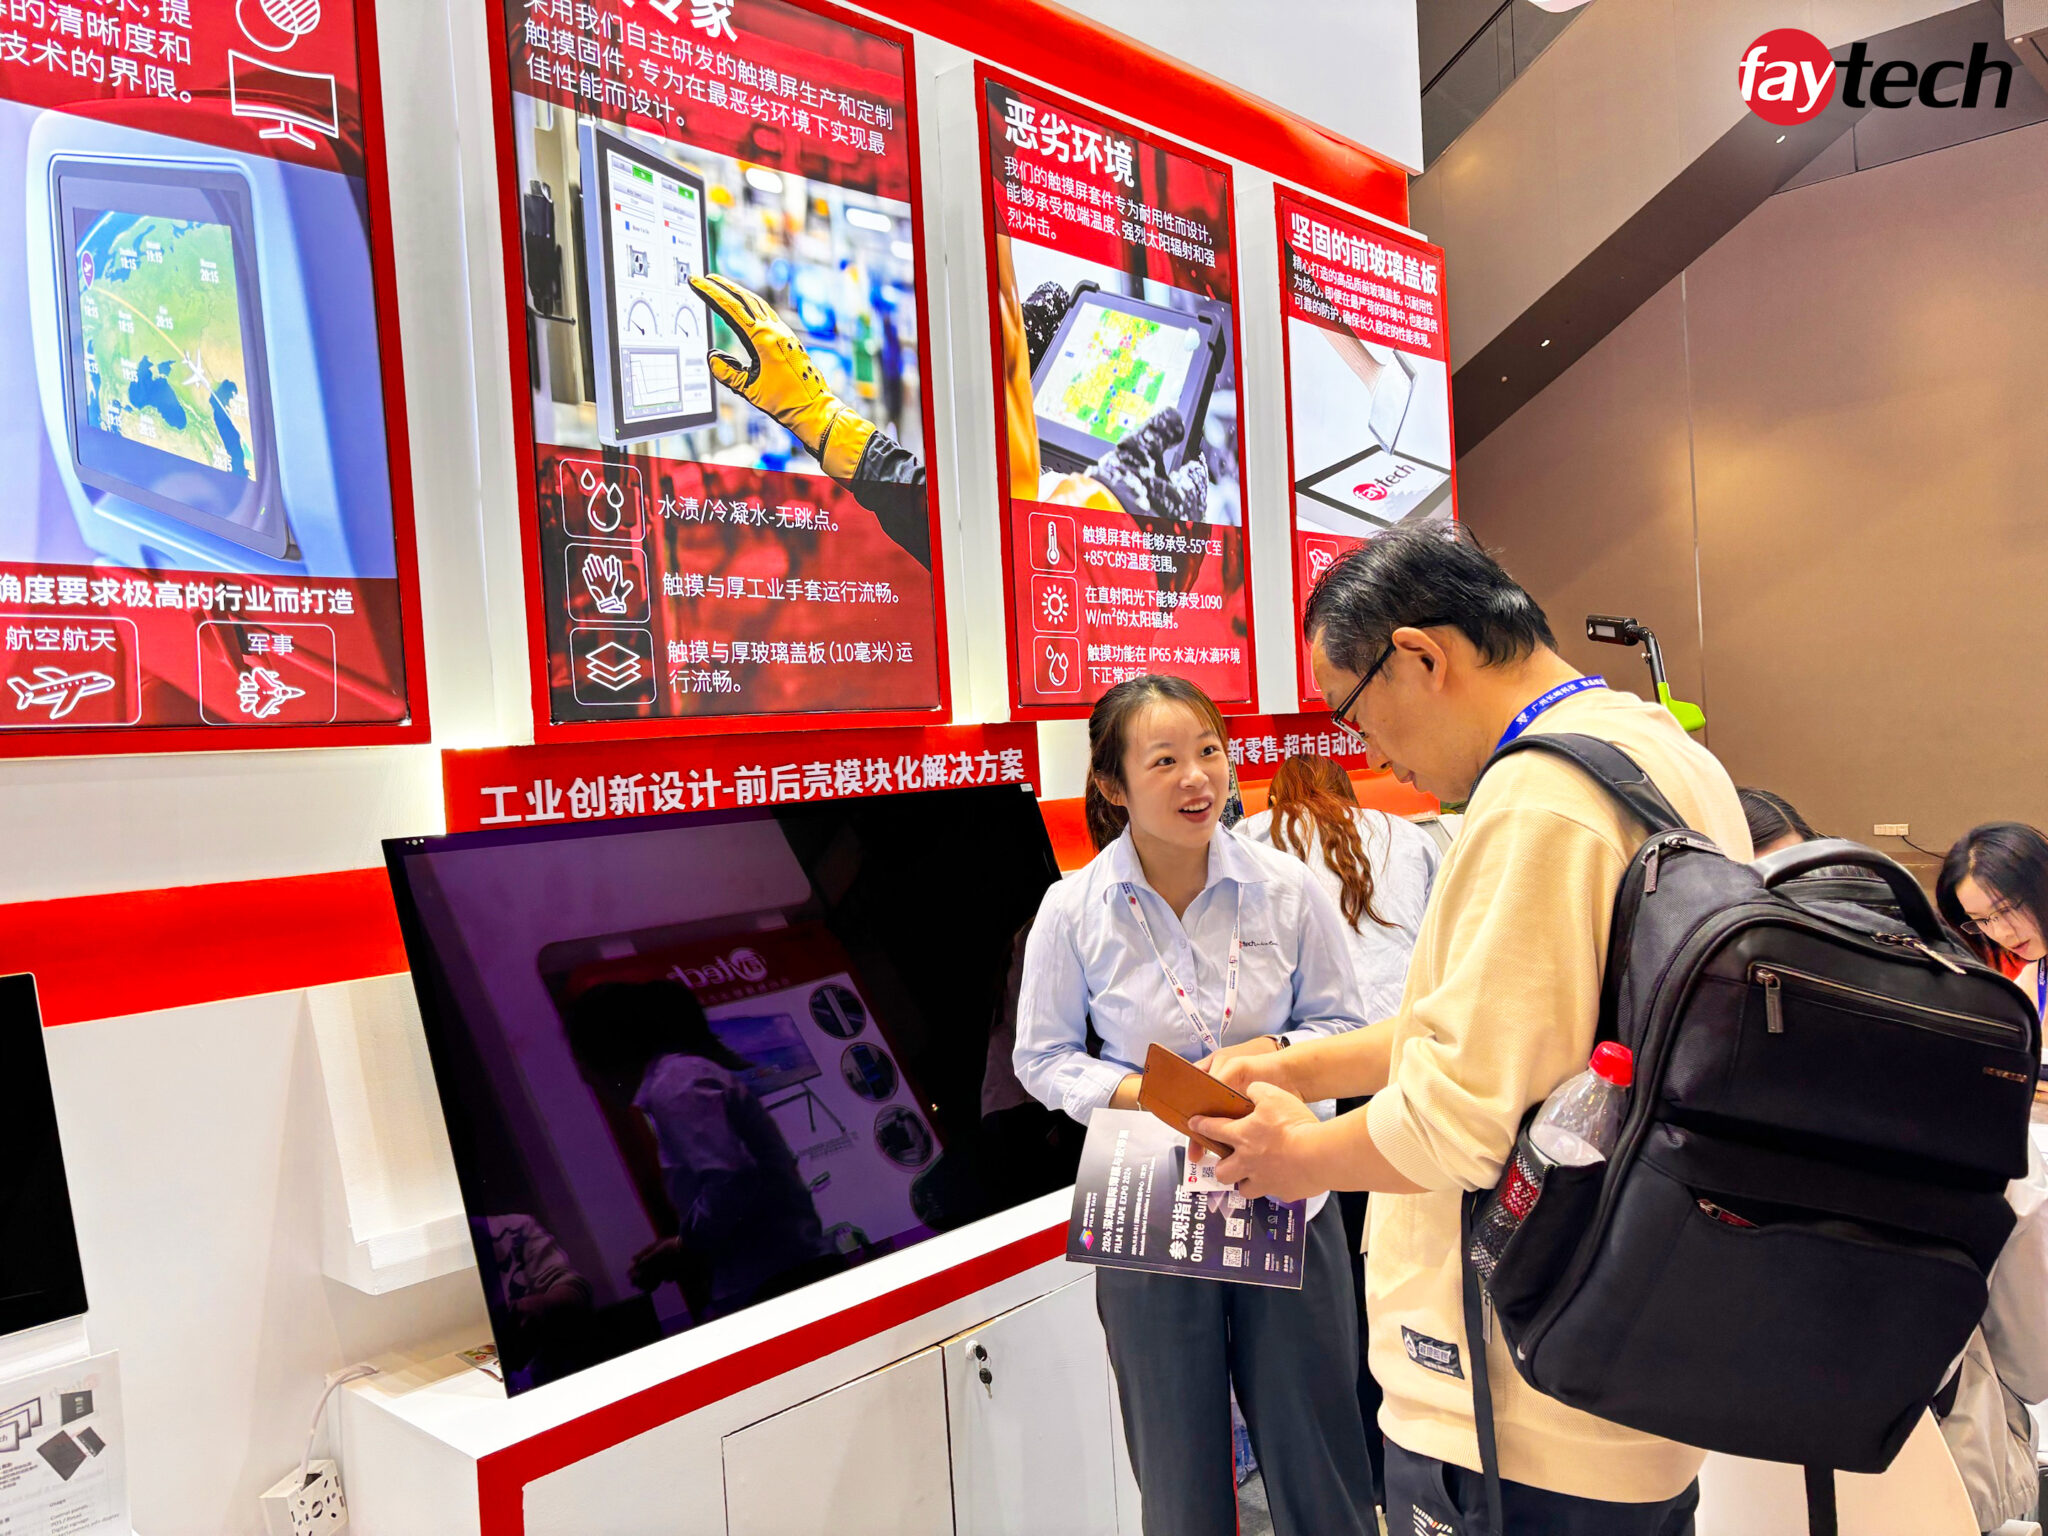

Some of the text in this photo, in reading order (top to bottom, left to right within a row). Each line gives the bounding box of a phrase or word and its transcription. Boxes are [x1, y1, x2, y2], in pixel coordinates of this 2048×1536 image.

[0, 0, 191, 65] 的清晰度和
[526, 53, 686, 128] 佳性能而设计。
[1004, 97, 1135, 188] 恶劣环境
[1007, 207, 1057, 241] 烈冲击。
[1291, 212, 1438, 296] 坚固的前玻璃盖板
[661, 572, 900, 604] 触摸与厚工业手套运行流畅。
[1085, 586, 1223, 610] 在直射阳光下能够承受1090
[5, 626, 117, 652] 航空航天
[247, 633, 295, 656] 军事
[1087, 643, 1147, 663] 触摸功能在
[1149, 647, 1171, 662] IP65
[669, 669, 742, 694] 行流畅。
[1227, 731, 1366, 766] 新零售-超市自动化
[479, 747, 1026, 826] 工业创新设计-前后壳模块化解决方案
[1119, 1185, 1129, 1205] EXPO
[1116, 1206, 1126, 1225] TAPE
[1168, 1184, 1193, 1261] 参观指南
[1113, 1234, 1123, 1254] FILM
[1190, 1222, 1206, 1263] Onsite
